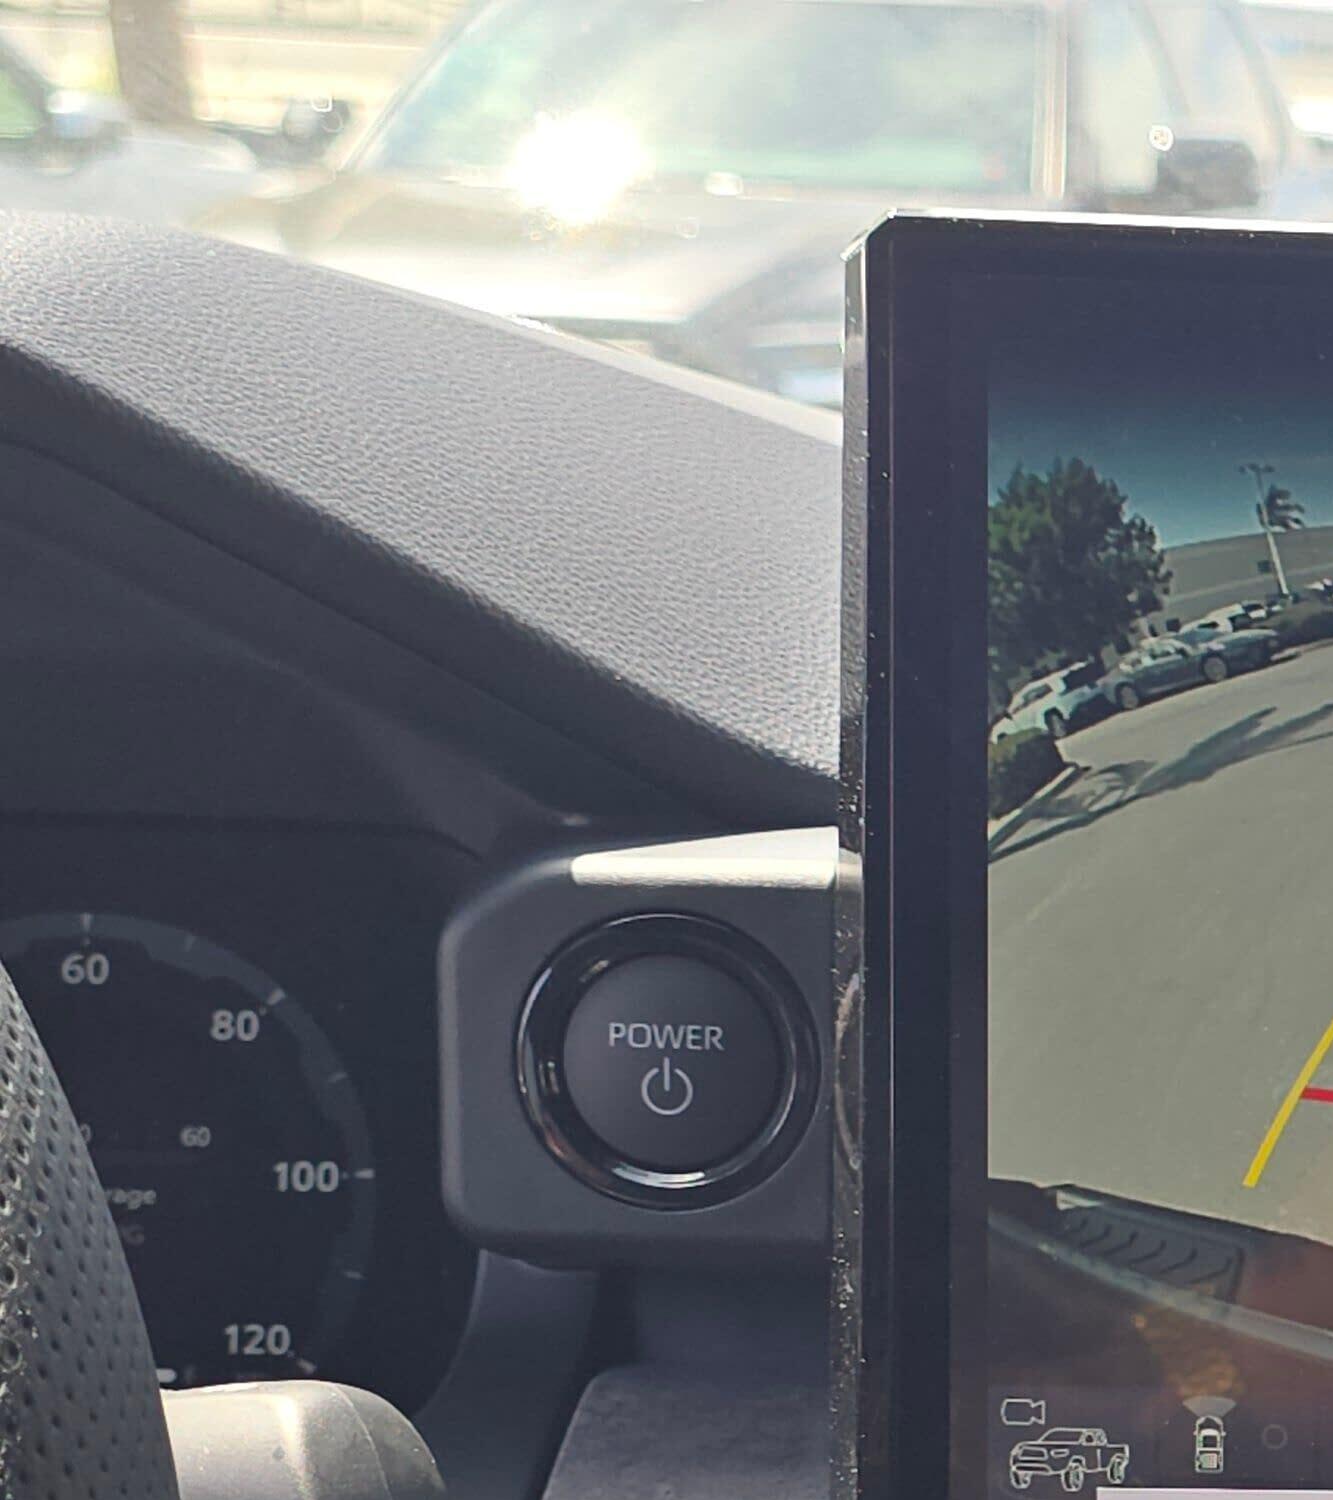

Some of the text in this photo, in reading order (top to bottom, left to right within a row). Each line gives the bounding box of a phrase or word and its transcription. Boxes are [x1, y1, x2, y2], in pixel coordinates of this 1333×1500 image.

[61, 953, 110, 985] 60
[210, 1010, 259, 1042] 80
[608, 1021, 723, 1050] POWER
[180, 1125, 212, 1148] 60
[273, 1160, 340, 1193] 100
[224, 1323, 291, 1355] 120
